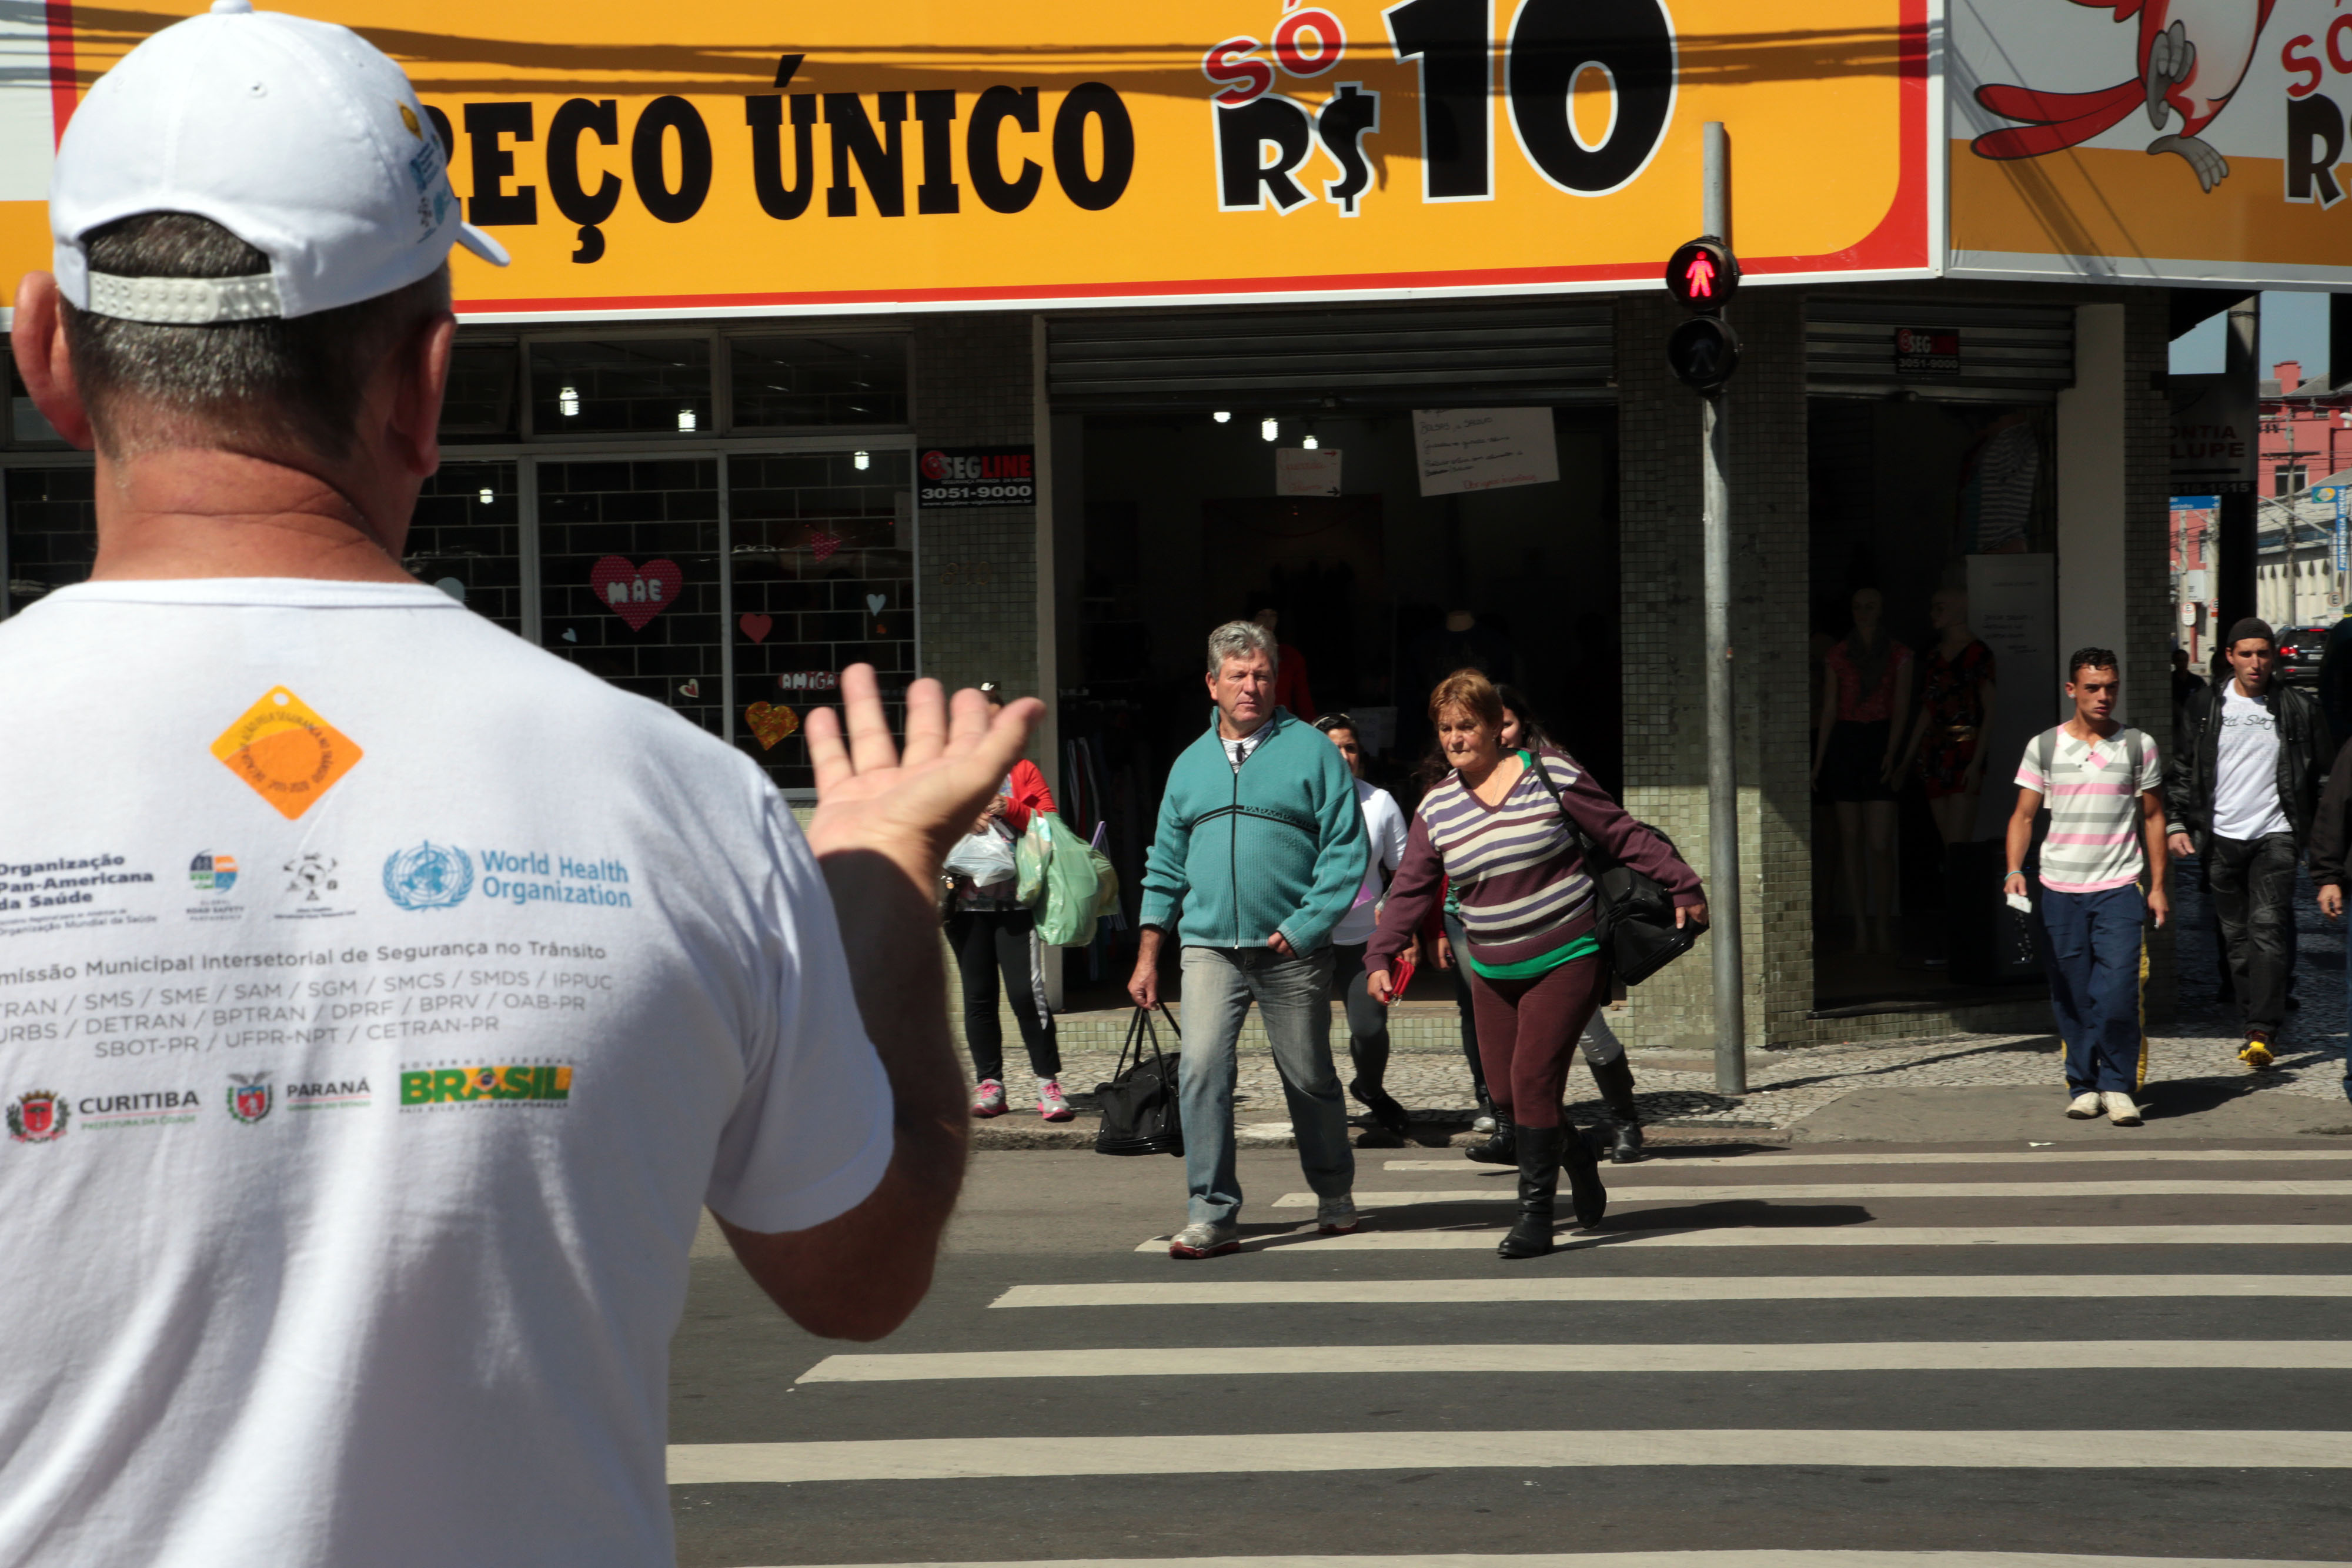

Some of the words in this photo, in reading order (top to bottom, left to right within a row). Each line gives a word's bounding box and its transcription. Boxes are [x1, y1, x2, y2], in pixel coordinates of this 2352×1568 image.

[1210, 81, 1381, 218] R$
[1381, 0, 1679, 198] 10
[744, 54, 1135, 221] ÚNICO
[2284, 92, 2352, 211] R
[921, 486, 1033, 499] 3051-9000
[606, 573, 663, 605] MÃE
[481, 851, 550, 875] World
[559, 856, 629, 882] Health
[29, 891, 93, 907] Saúde
[482, 875, 633, 908] Organization
[86, 955, 194, 974] Municipal
[202, 949, 333, 969] Intersetorial
[341, 947, 368, 963] de
[377, 941, 488, 962] Segurança
[496, 941, 522, 955] no
[528, 941, 607, 959] Trânsito
[84, 990, 134, 1011] SMS
[161, 987, 208, 1005] SME
[235, 982, 282, 1000] SAM
[308, 979, 357, 998] SGM
[384, 972, 446, 992] SMCS
[470, 970, 530, 987] SMDS
[553, 972, 613, 990] IPPUC
[86, 1012, 186, 1035] DETRAN
[213, 1006, 306, 1027] BPTRAN
[332, 999, 393, 1020] DPRF
[419, 994, 481, 1012] BPRV
[503, 992, 586, 1011] OAB-PR
[95, 1035, 199, 1058] SBOT-PR
[225, 1027, 339, 1048] UFPR-NPT
[366, 1016, 499, 1041] CETRAN-PR
[79, 1091, 199, 1114] CURITIBA
[286, 1076, 370, 1097] PARANÁ
[401, 1066, 569, 1106] BRASIL
